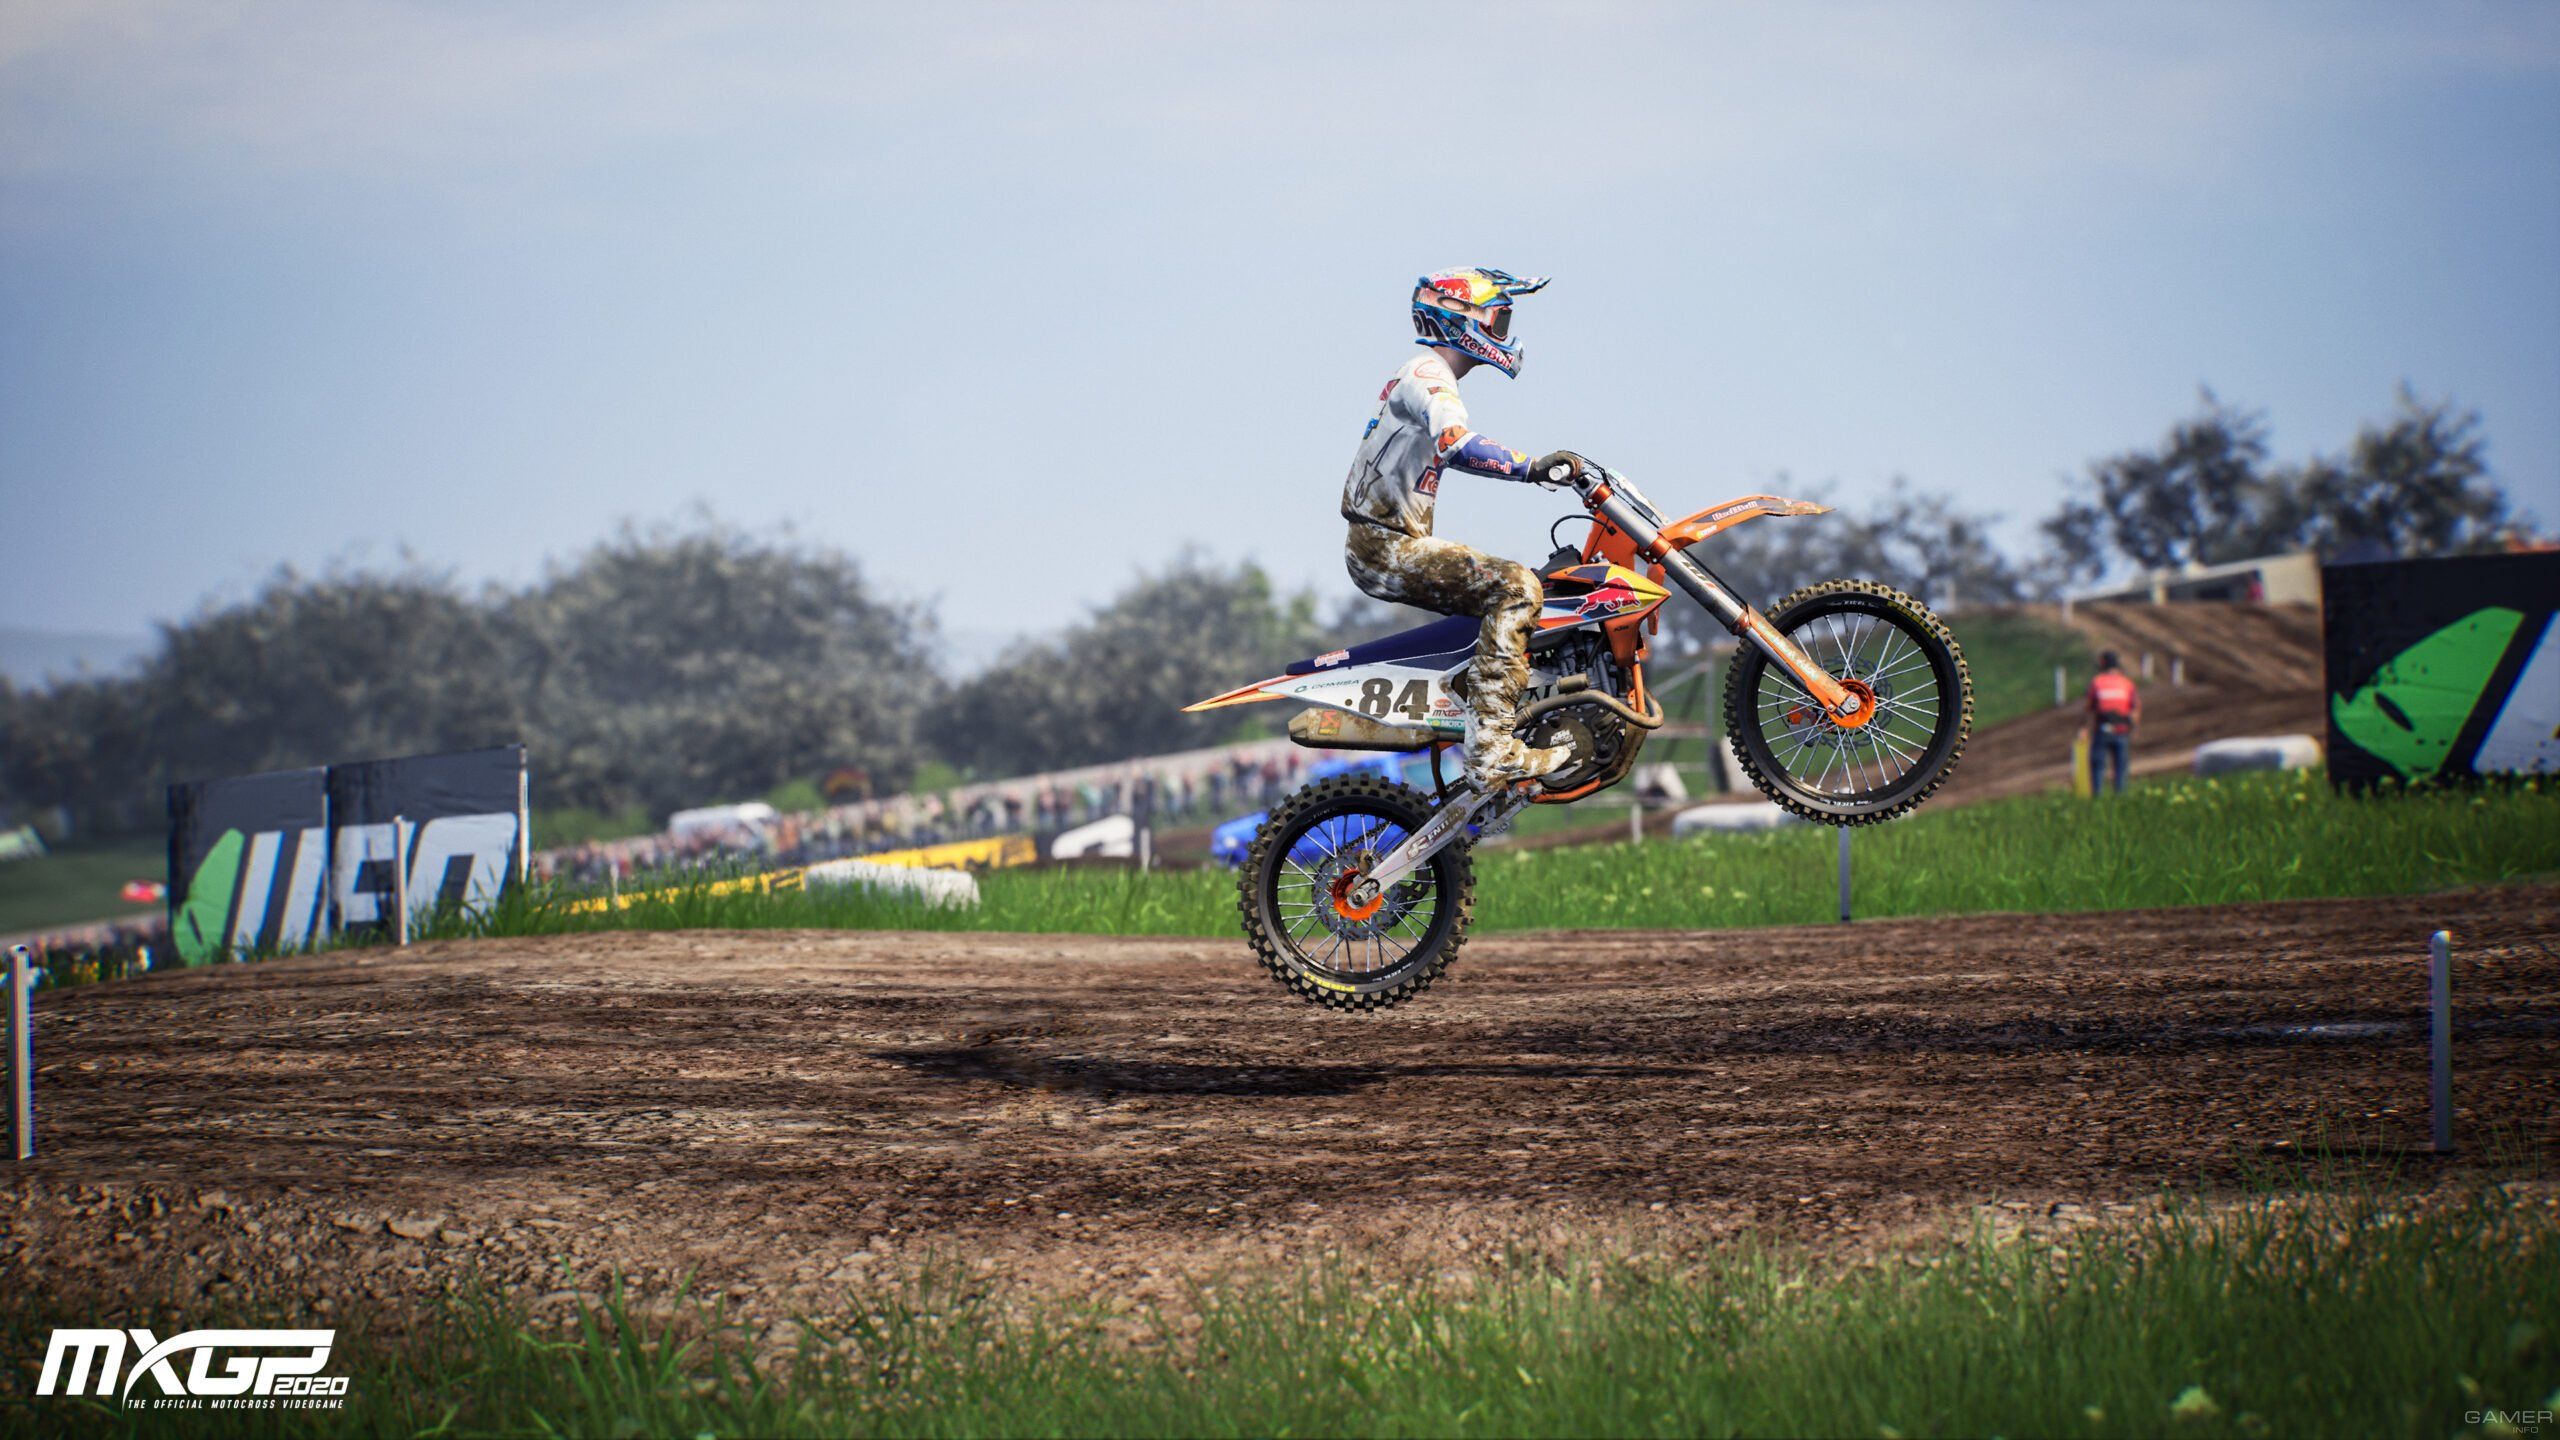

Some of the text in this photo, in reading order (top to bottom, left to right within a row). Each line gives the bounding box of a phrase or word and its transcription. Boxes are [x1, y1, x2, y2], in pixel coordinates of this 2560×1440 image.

[1460, 333, 1515, 369] Red Bull
[1470, 457, 1512, 475] Red Bull
[1359, 678, 1430, 720] 84
